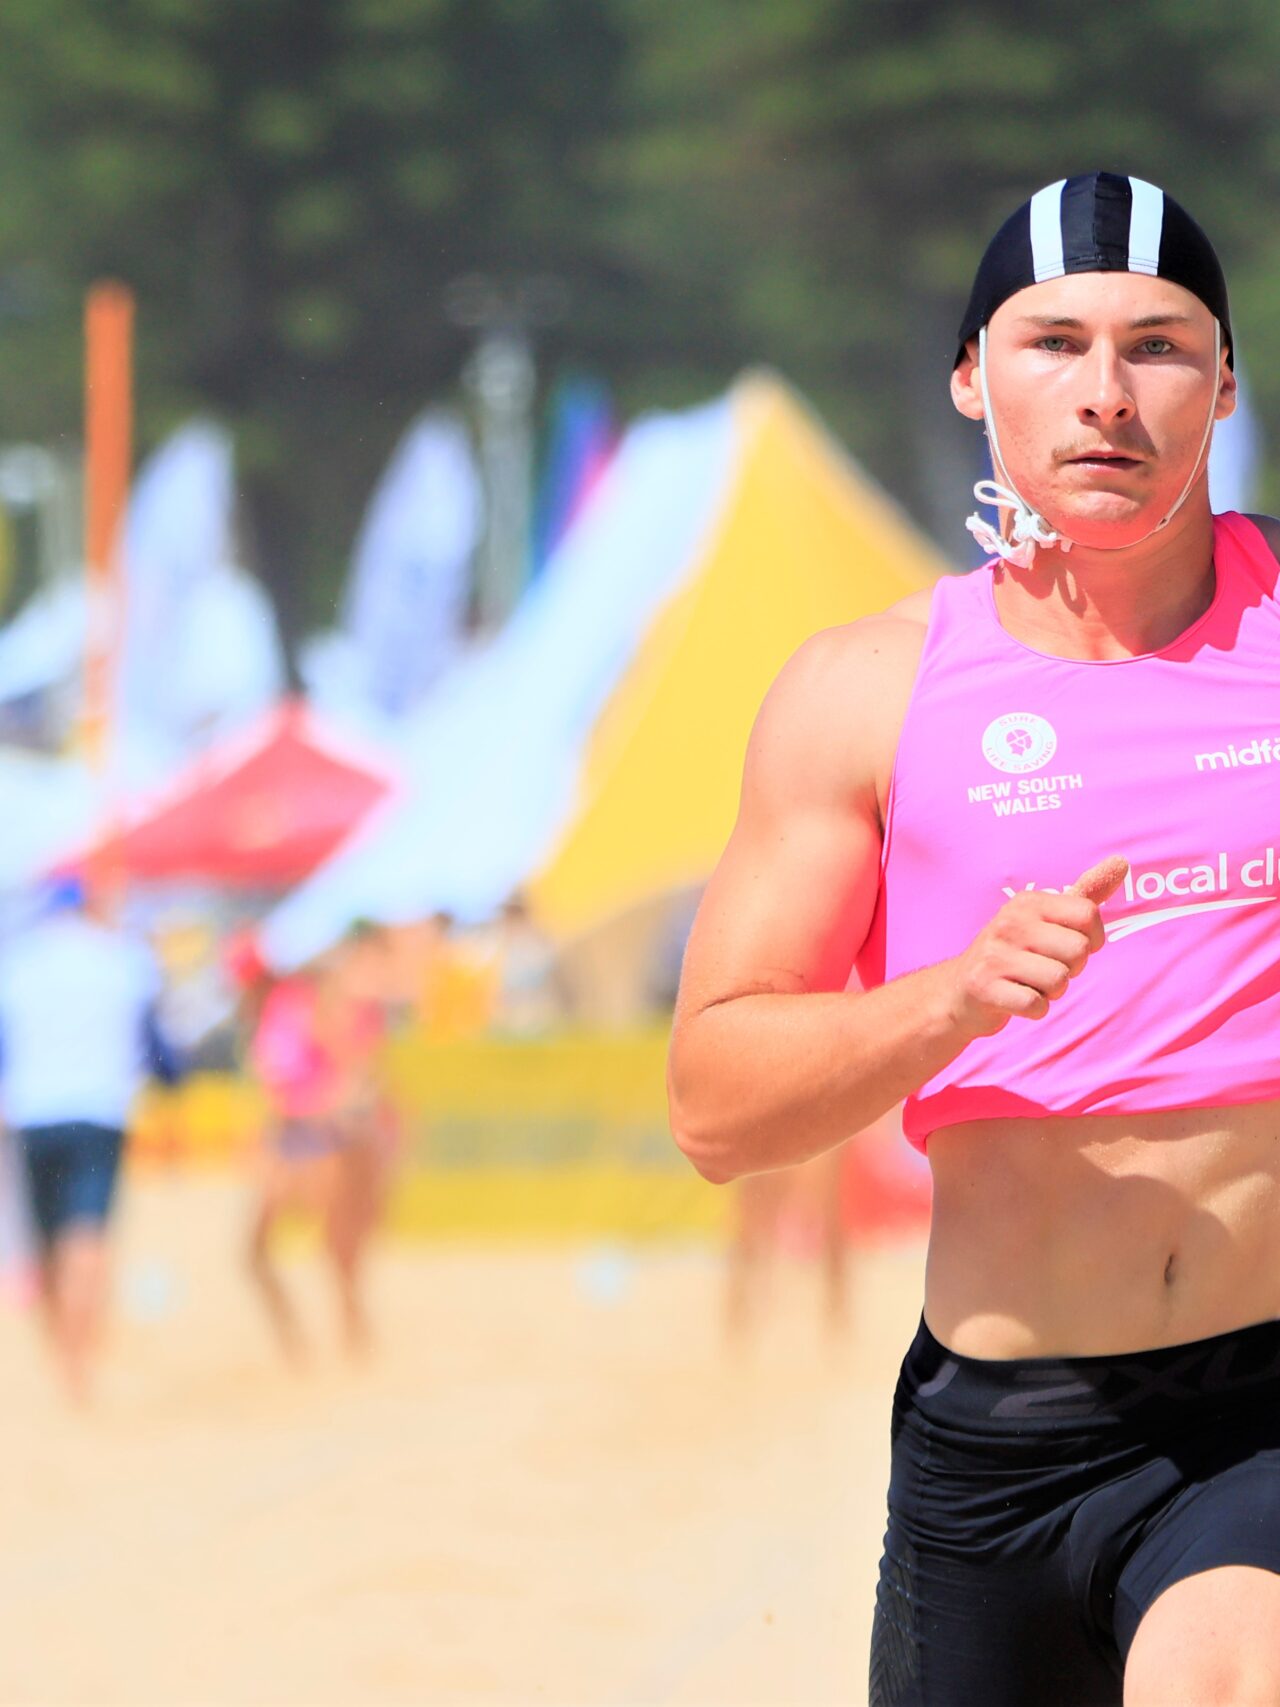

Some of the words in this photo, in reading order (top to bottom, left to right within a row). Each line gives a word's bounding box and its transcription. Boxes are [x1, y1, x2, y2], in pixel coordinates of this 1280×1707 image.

[1013, 741, 1054, 771] SAVING
[967, 781, 1011, 804] NEW
[1017, 773, 1083, 795] SOUTH
[992, 793, 1062, 817] WALES
[1124, 852, 1227, 902] local
